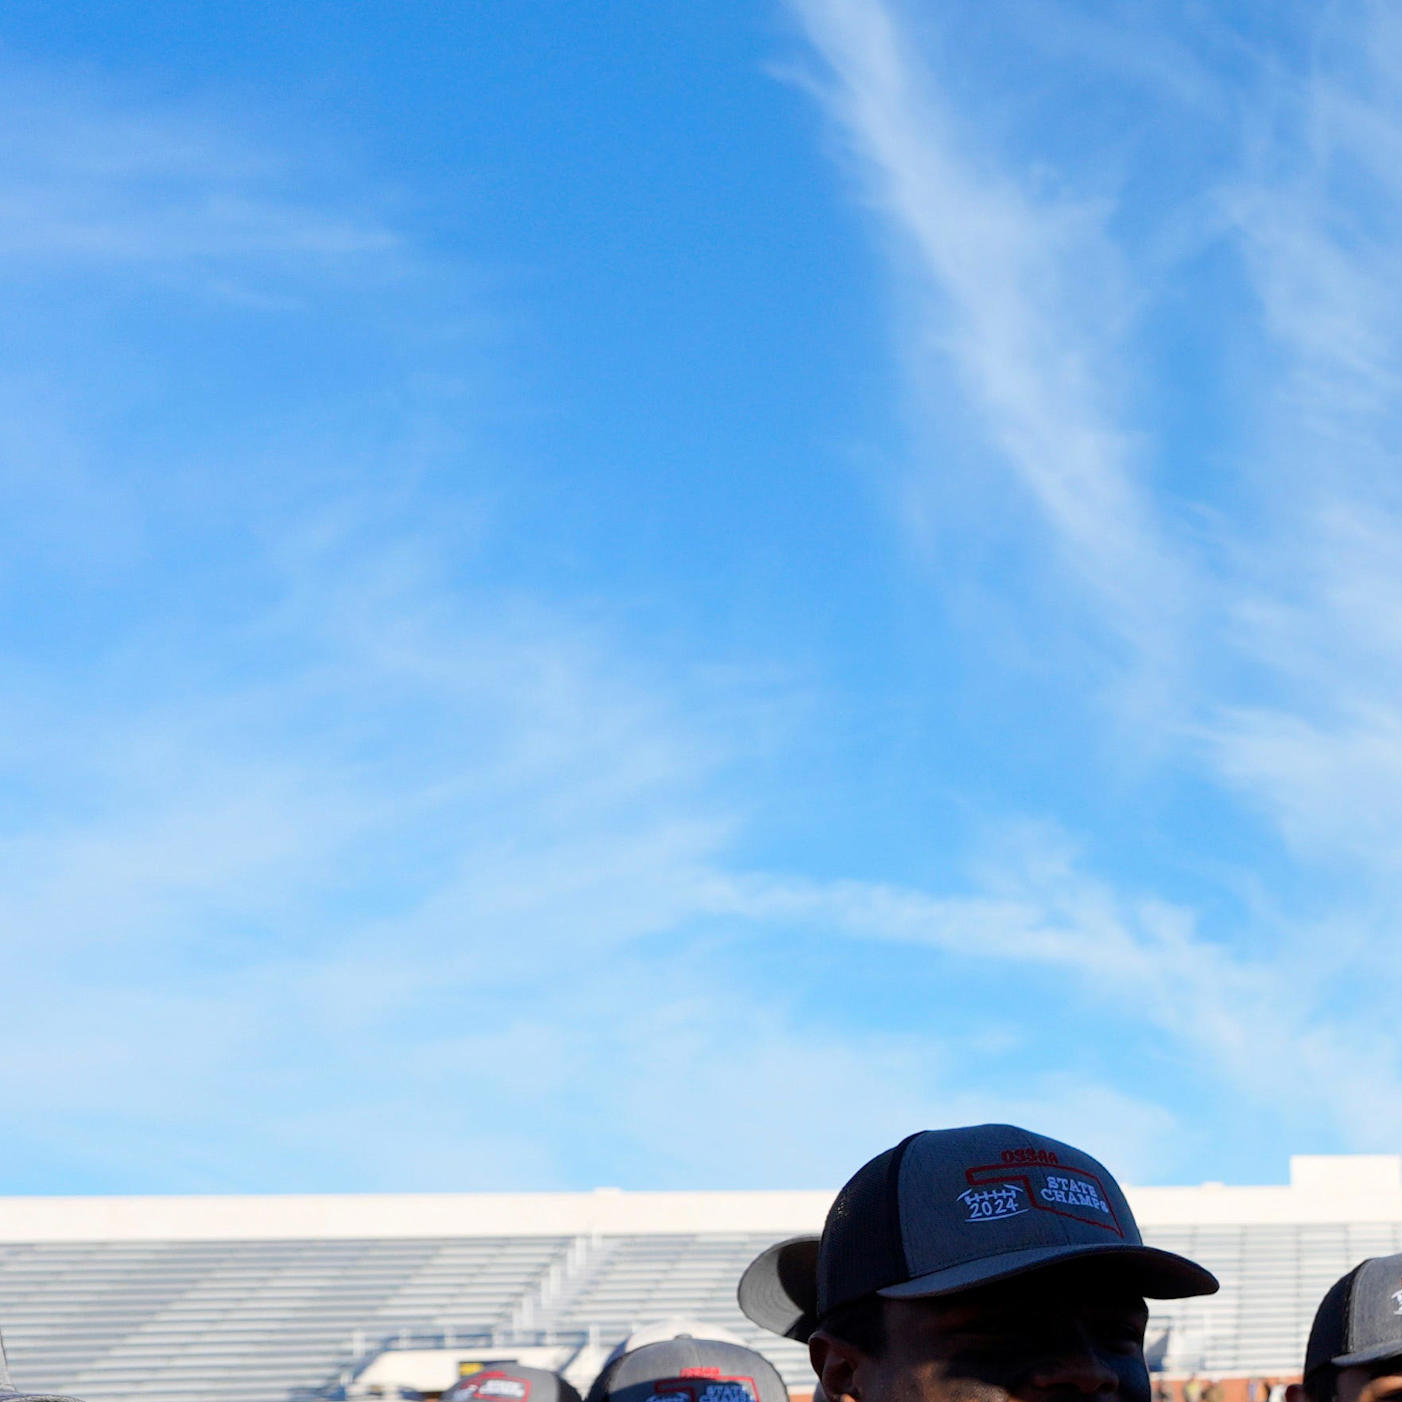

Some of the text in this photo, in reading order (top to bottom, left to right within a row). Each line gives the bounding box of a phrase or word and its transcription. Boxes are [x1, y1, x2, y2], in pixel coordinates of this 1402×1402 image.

[1047, 1176, 1098, 1198] STATE
[968, 1198, 1019, 1219] 2024
[1041, 1188, 1110, 1214] CHAMPS
